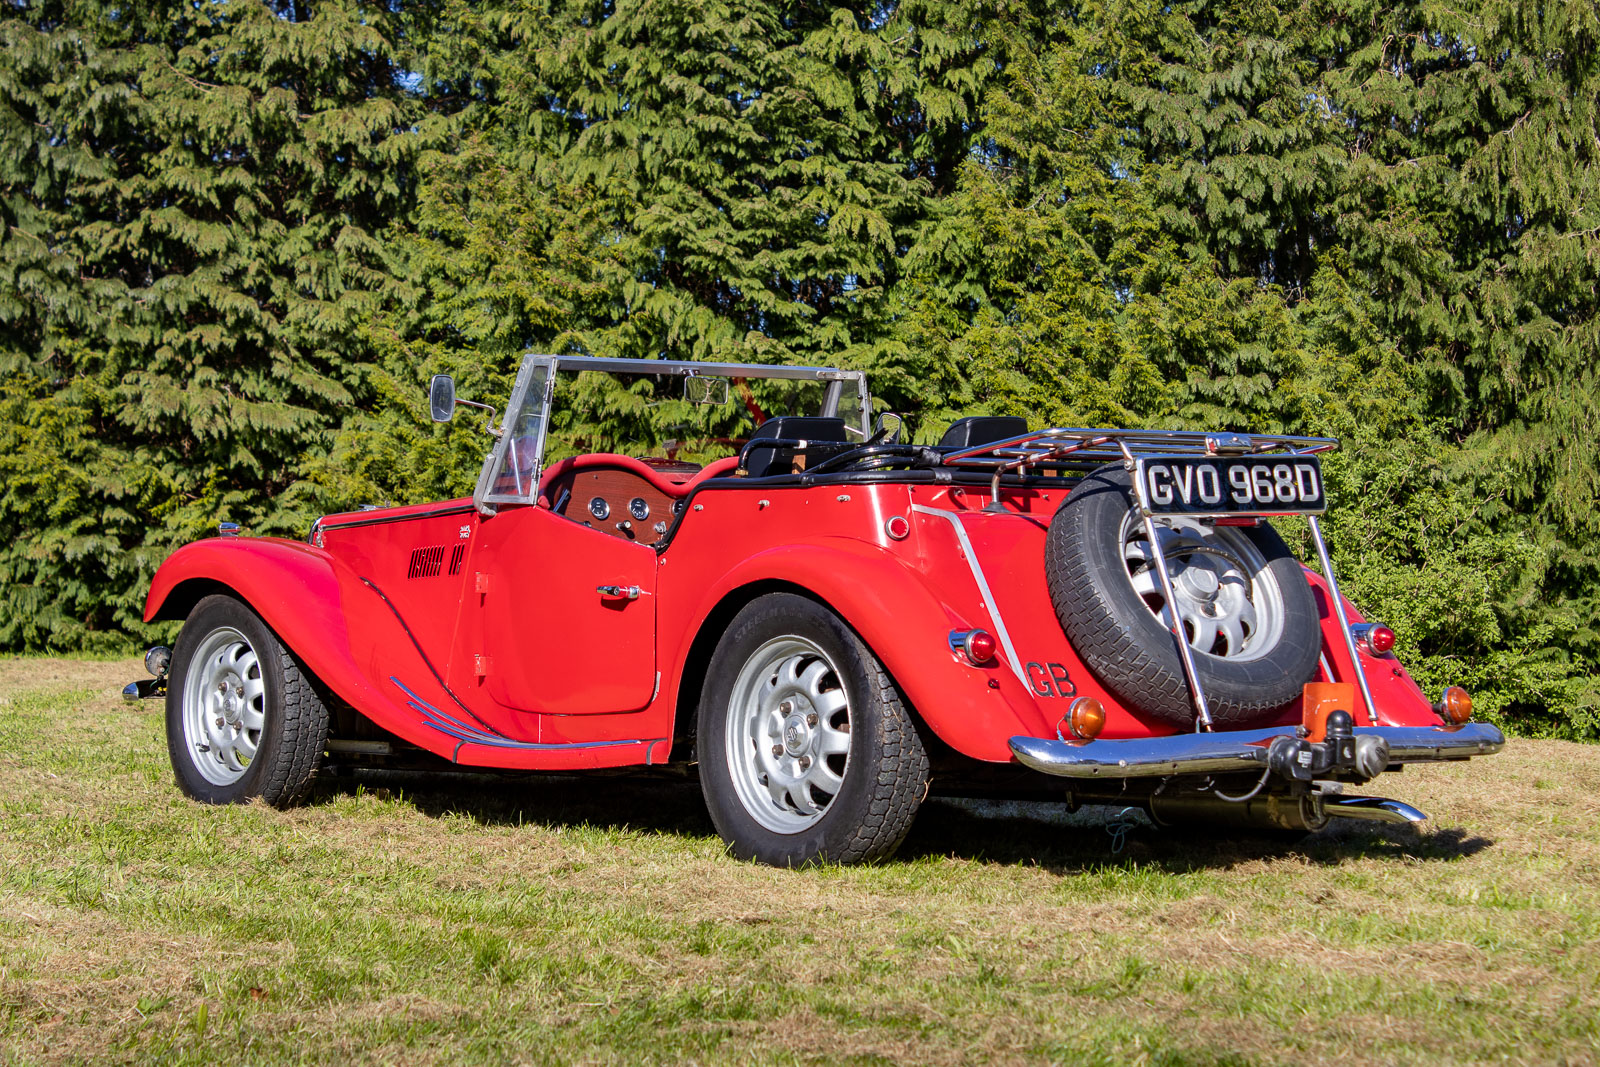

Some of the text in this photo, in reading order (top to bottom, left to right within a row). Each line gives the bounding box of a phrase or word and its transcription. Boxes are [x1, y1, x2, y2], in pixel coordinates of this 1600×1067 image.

[1148, 463, 1320, 505] GVO 968D
[1026, 661, 1077, 698] GB
